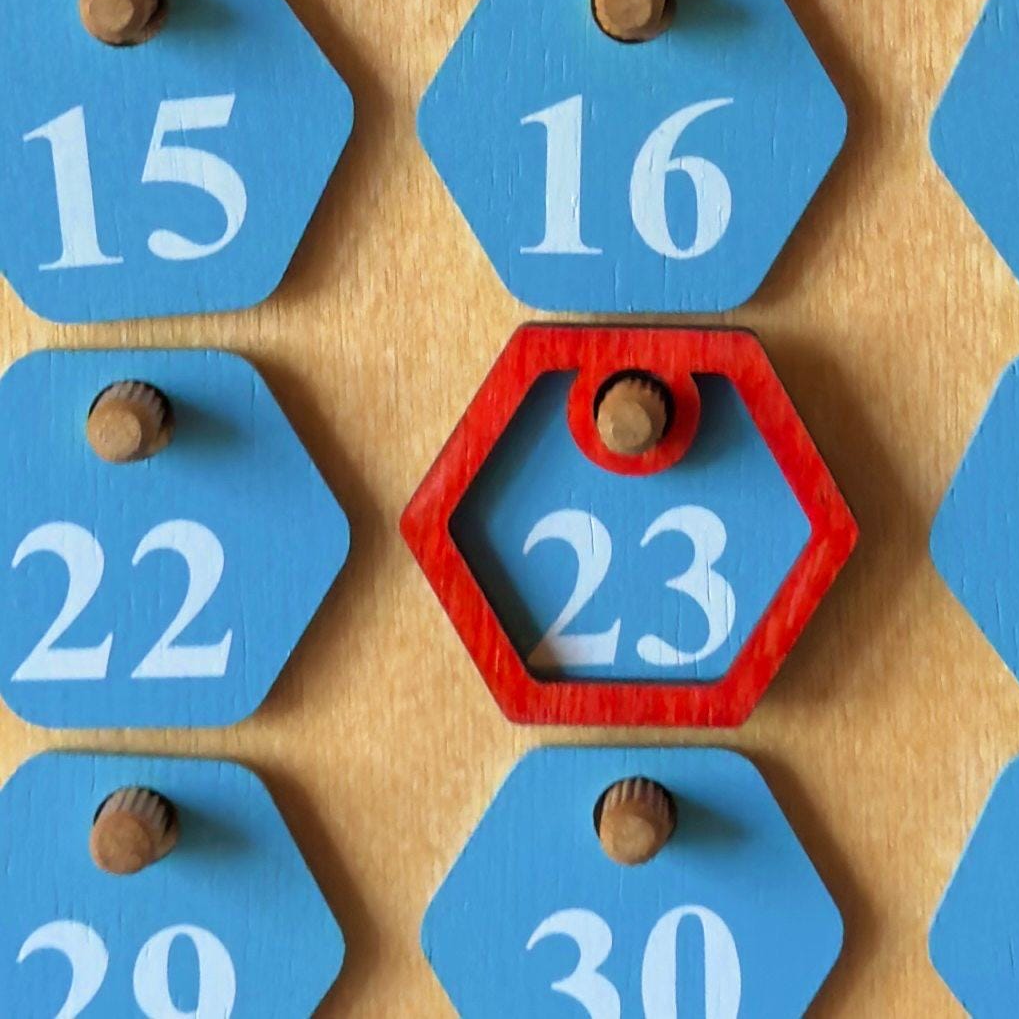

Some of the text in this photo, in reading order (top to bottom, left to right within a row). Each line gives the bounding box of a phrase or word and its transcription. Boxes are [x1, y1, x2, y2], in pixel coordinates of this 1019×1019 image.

[24, 94, 248, 270] 15
[520, 95, 736, 259] 16
[11, 519, 232, 681] 22
[521, 504, 736, 666] 23
[17, 920, 237, 1019] 29
[527, 904, 742, 1019] 30
